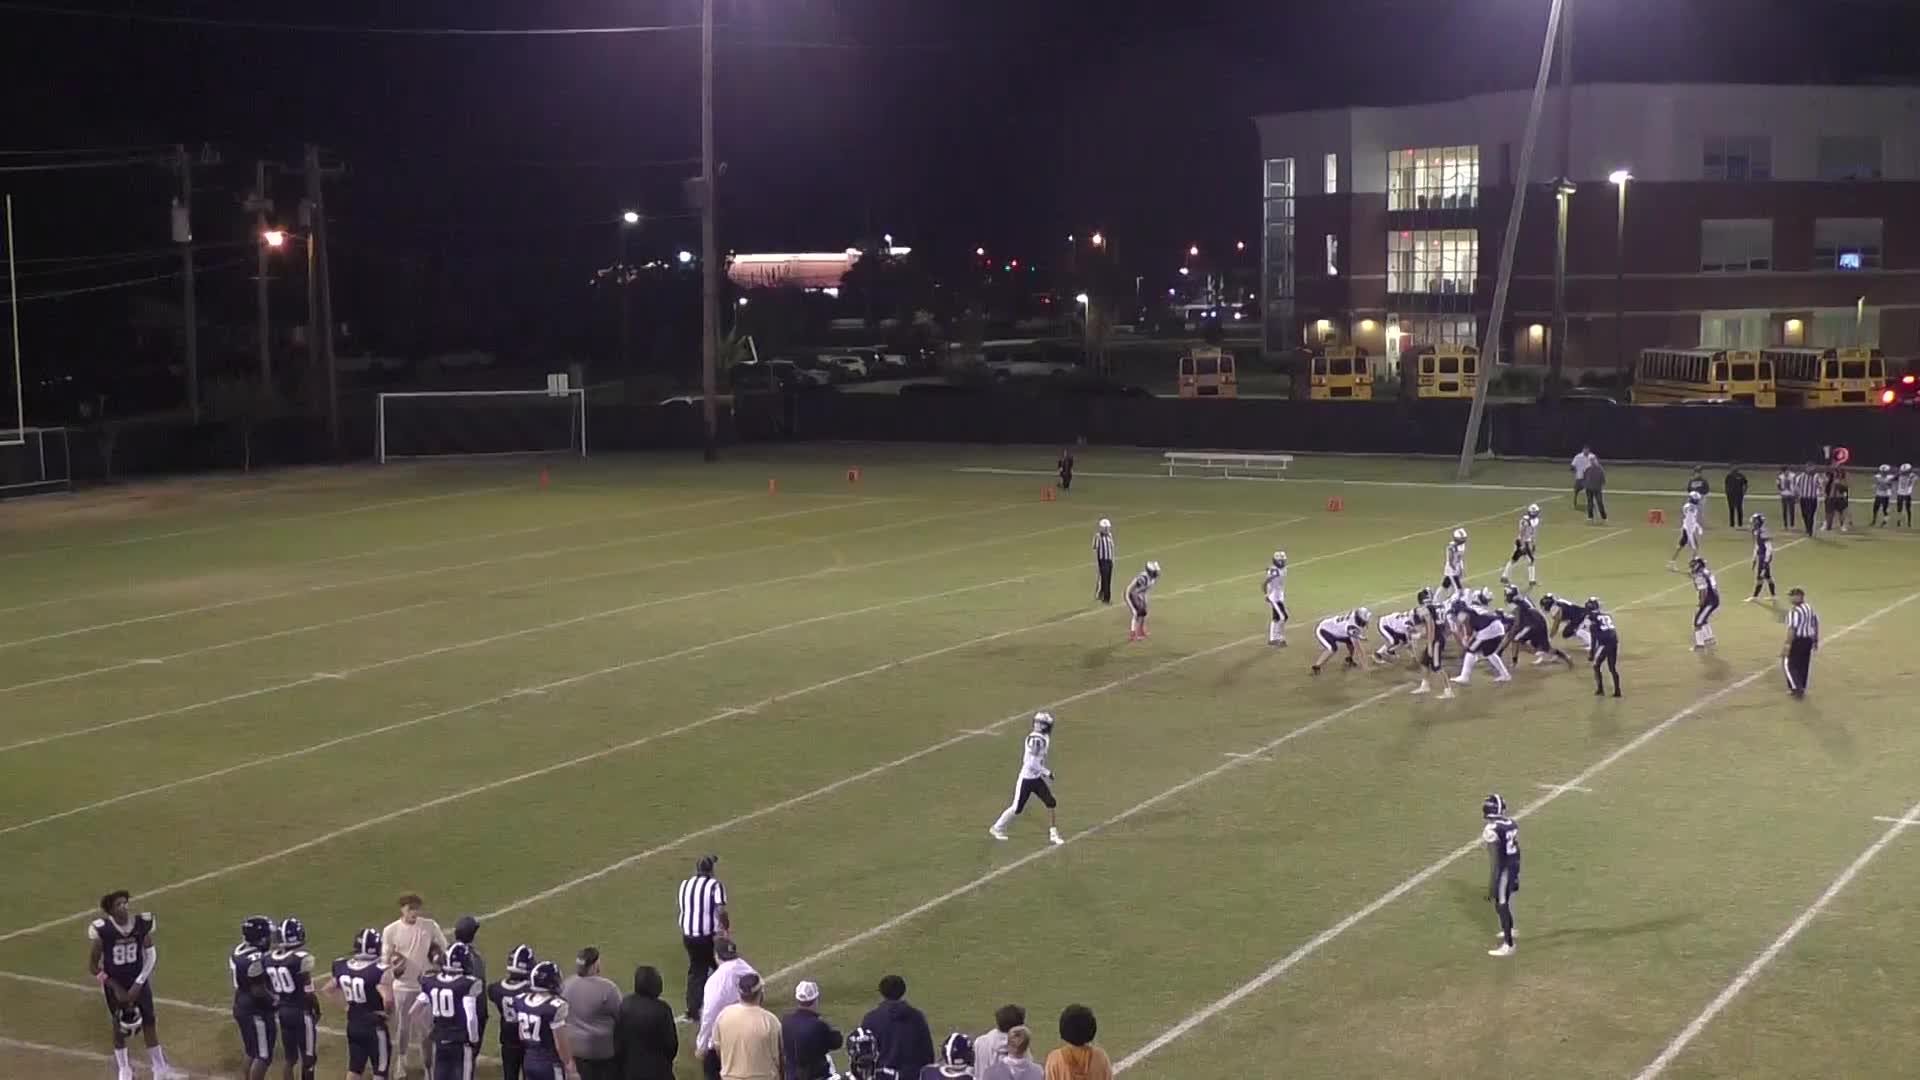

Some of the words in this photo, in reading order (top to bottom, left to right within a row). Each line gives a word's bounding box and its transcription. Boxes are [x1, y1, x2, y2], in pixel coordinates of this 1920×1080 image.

[112, 943, 138, 966] 88
[339, 974, 367, 1003] 60
[430, 988, 456, 1017] 10
[517, 1012, 541, 1042] 27
